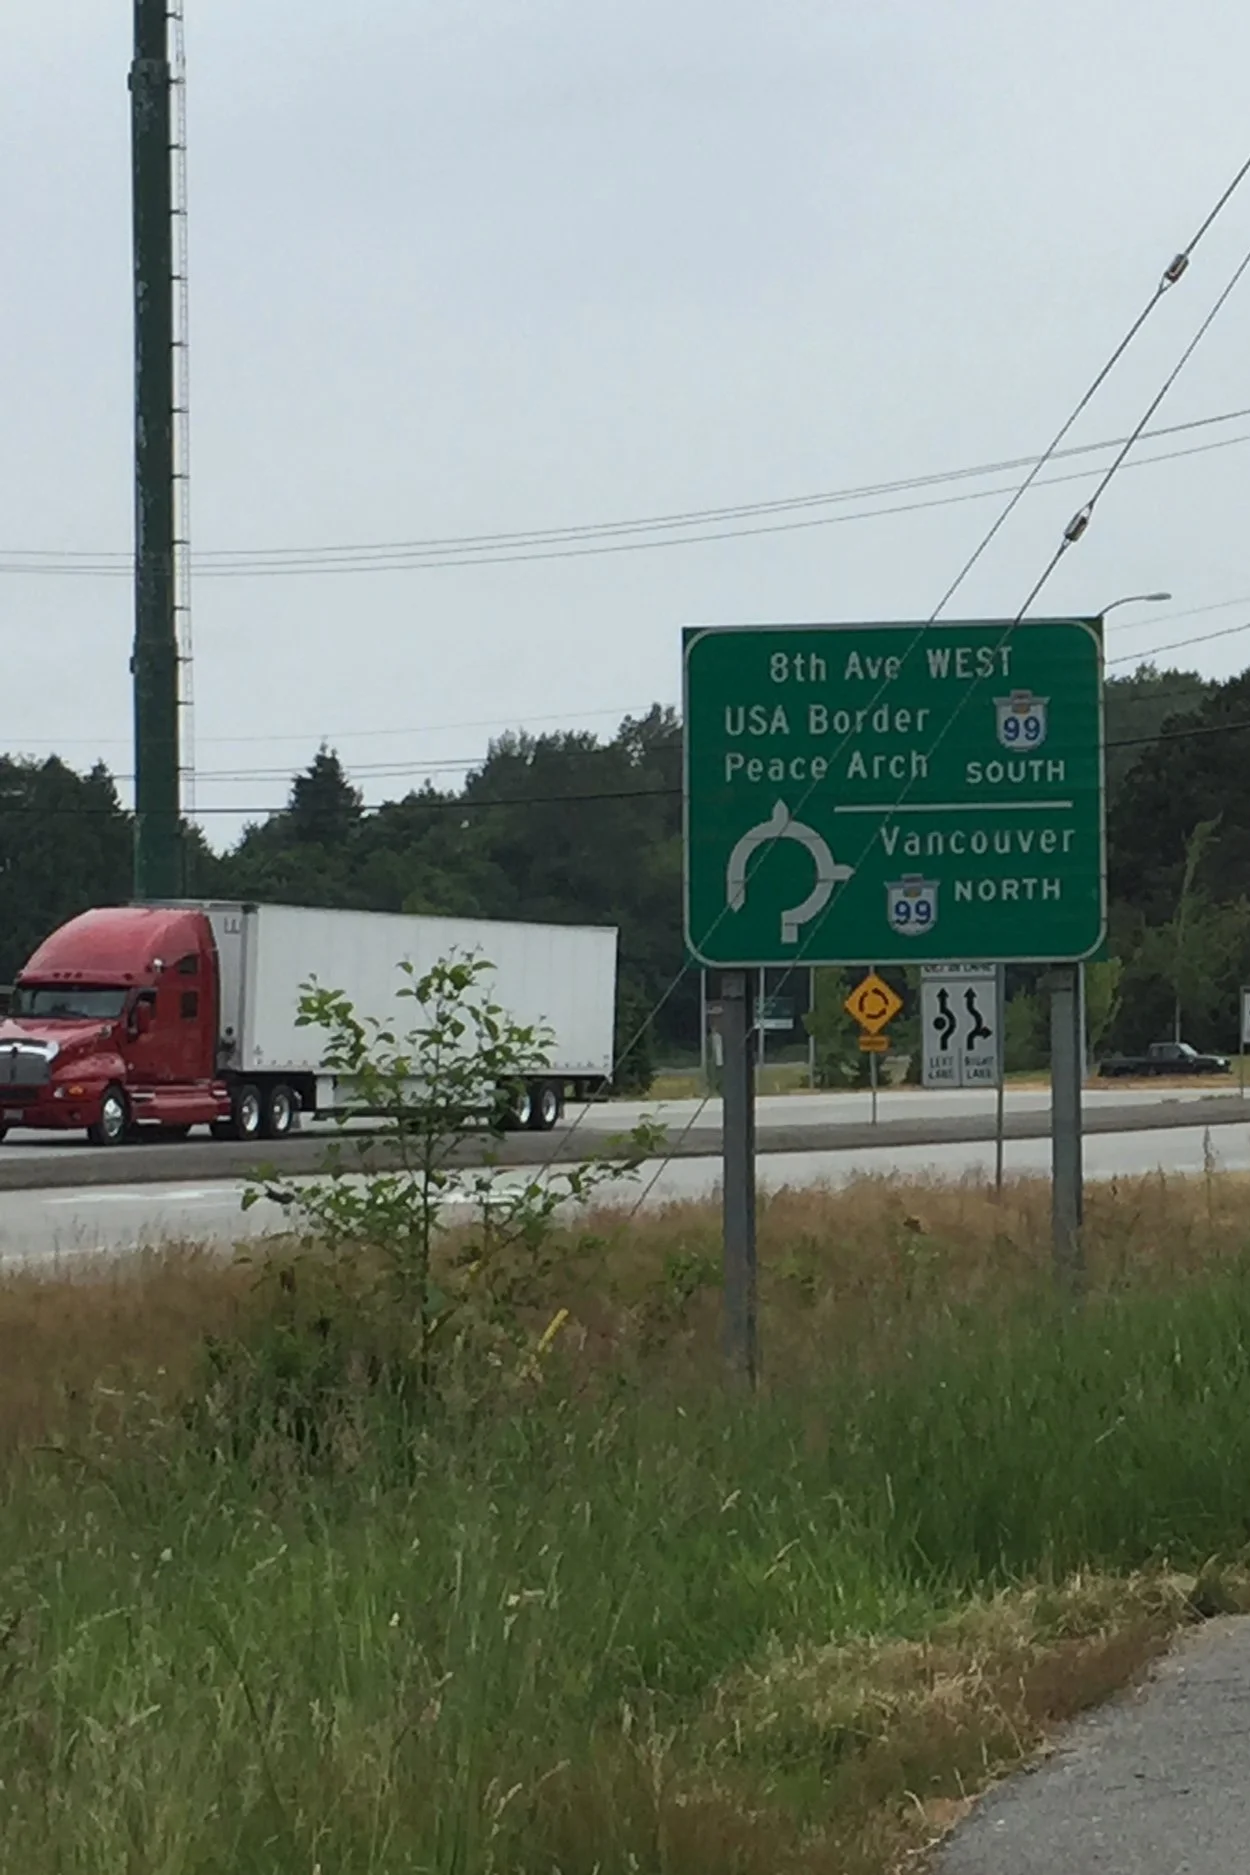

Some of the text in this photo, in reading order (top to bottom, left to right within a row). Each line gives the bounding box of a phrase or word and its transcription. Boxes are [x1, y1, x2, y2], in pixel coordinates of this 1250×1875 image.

[769, 646, 1013, 683] 8th Ave WEST
[725, 703, 931, 736] USA Border
[1003, 715, 1041, 741] 99
[725, 750, 928, 783] Peace Arch
[966, 760, 1066, 784] SOUTH
[880, 826, 1076, 856] Vancouver
[954, 878, 1062, 902] NORTH
[894, 899, 932, 926] 99
